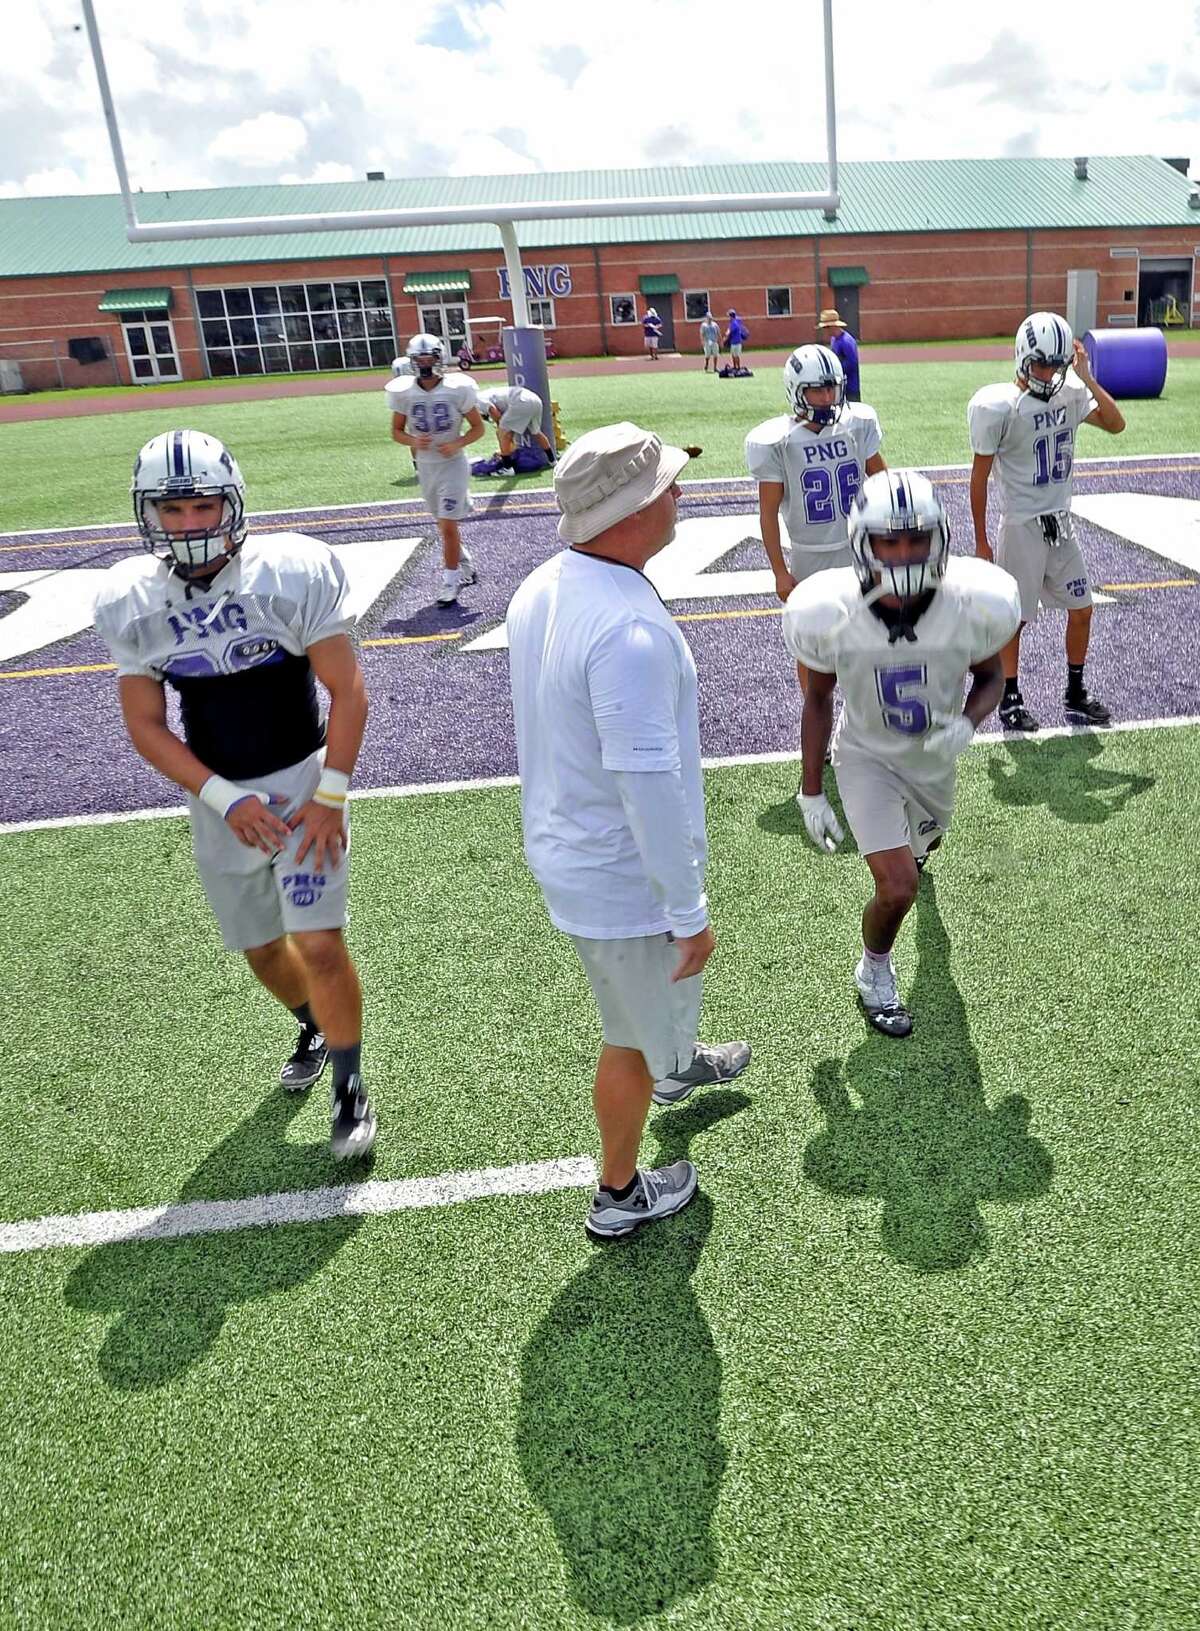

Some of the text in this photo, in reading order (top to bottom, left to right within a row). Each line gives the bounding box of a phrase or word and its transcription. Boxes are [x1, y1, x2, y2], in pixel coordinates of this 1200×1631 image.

[1033, 406, 1067, 431] PNG
[803, 440, 848, 464] PNG
[1032, 428, 1073, 487] 15
[800, 459, 861, 525] 26
[874, 663, 932, 737] 5
